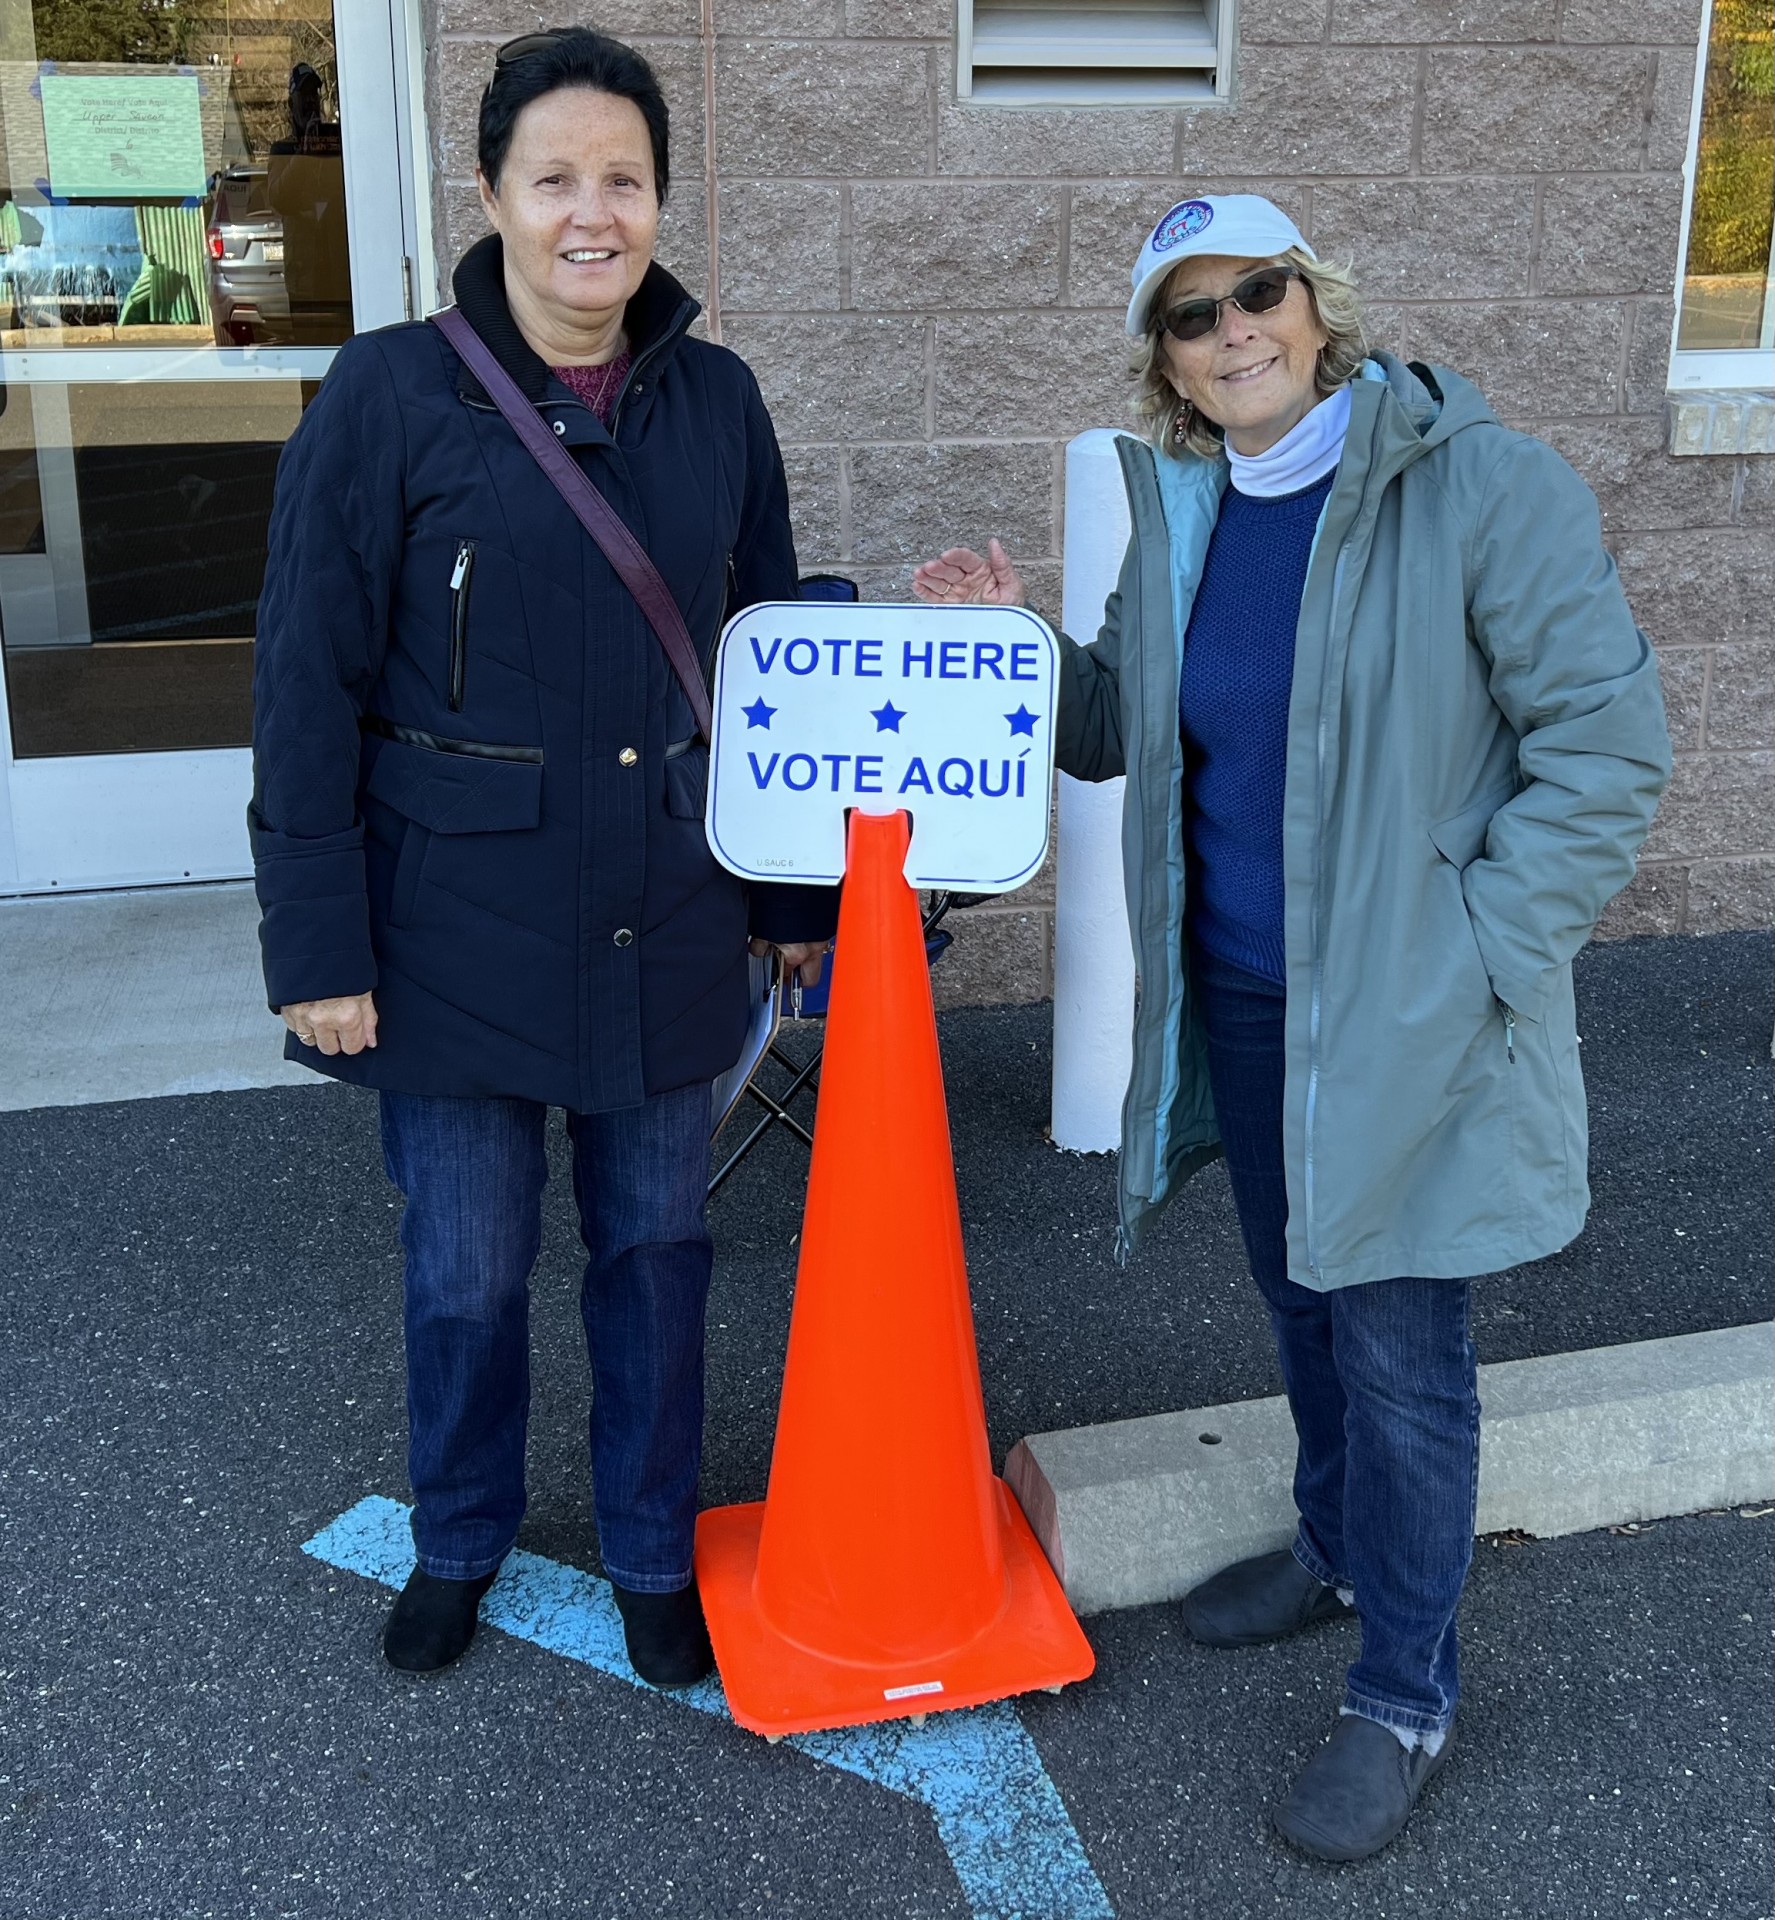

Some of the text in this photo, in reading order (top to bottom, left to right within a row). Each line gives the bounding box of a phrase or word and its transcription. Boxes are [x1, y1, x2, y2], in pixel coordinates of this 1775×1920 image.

[82, 110, 116, 126] Upper
[750, 637, 1039, 681] VOTE HERE
[747, 747, 1032, 799] VOTE AQUÍ
